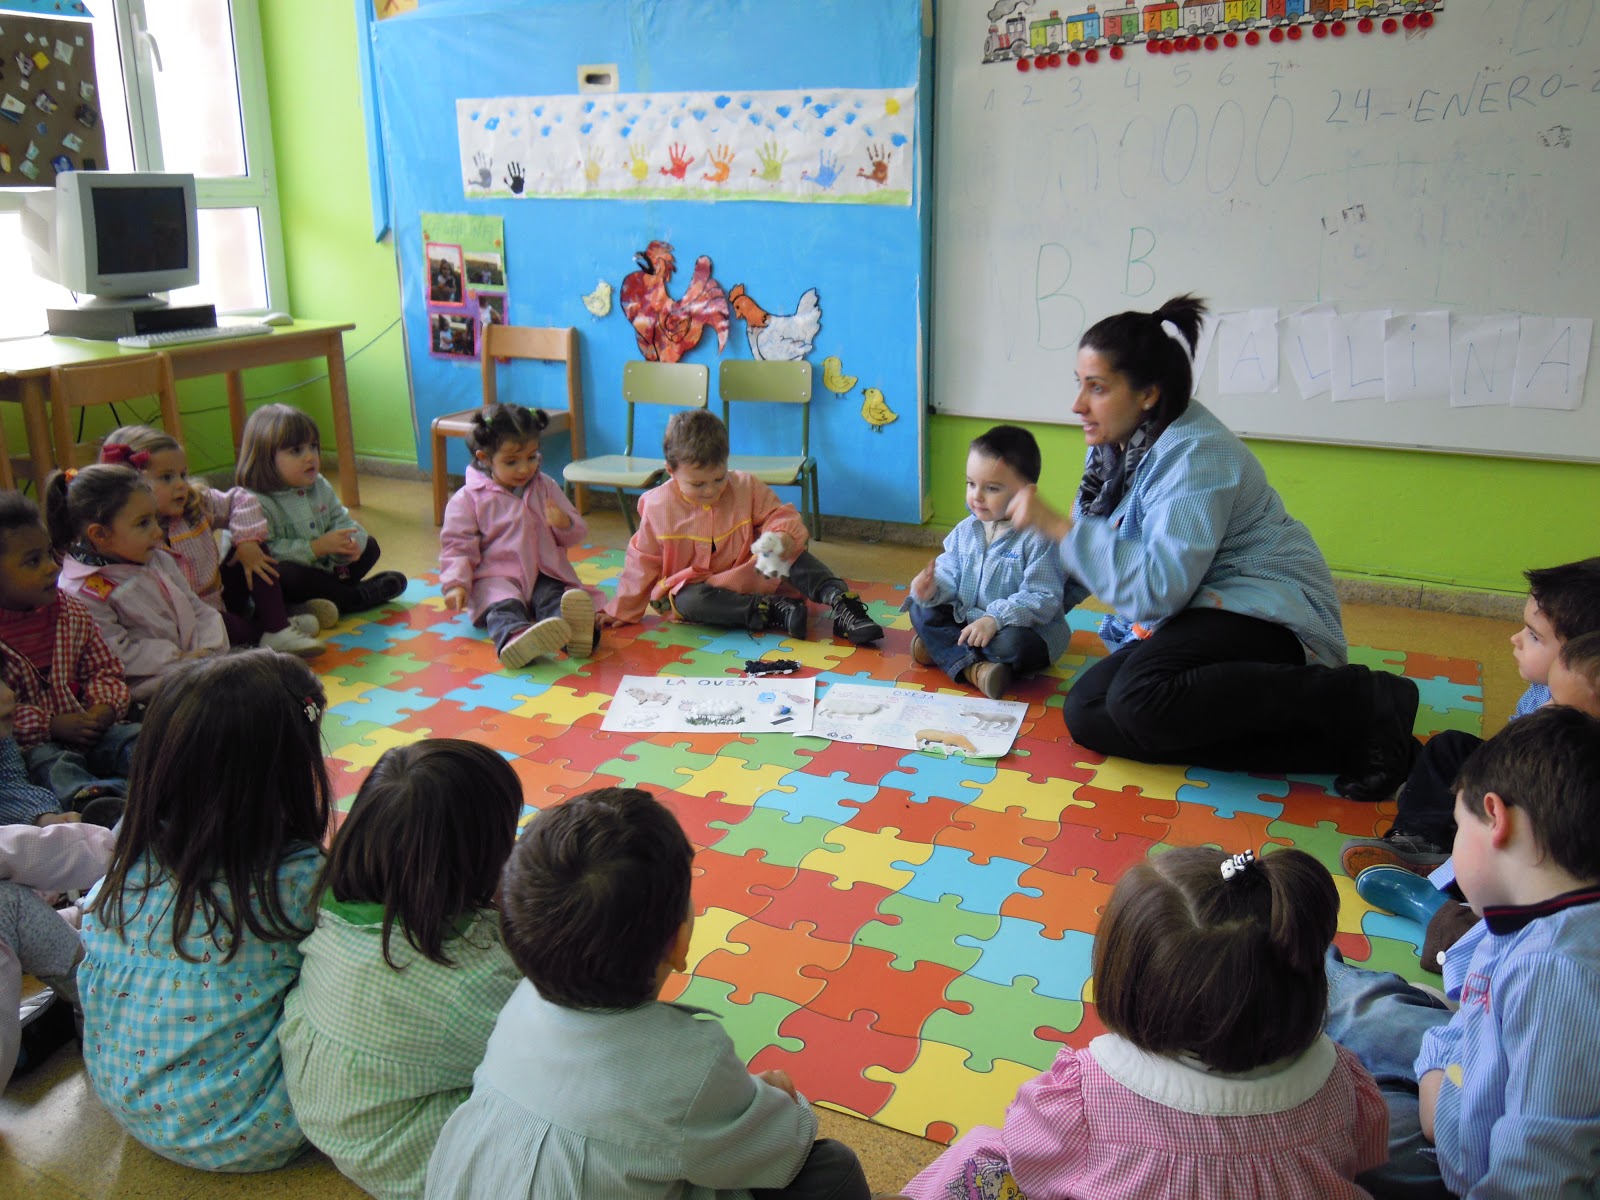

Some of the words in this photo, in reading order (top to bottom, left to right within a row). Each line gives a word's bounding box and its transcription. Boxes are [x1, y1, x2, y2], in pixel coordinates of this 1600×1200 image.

[1108, 17, 1117, 28] 5
[1166, 11, 1173, 22] 8
[1189, 8, 1197, 19] 9
[1202, 5, 1214, 17] 10
[1226, 3, 1239, 14] 11
[1245, 0, 1257, 12] 12
[1022, 84, 1042, 104] 2
[1064, 76, 1083, 108] 3
[1124, 66, 1141, 102] 4
[1173, 62, 1192, 88] 5
[1217, 61, 1235, 86] 6
[1267, 61, 1286, 89] 7
[1036, 242, 1086, 350] B
[1124, 226, 1156, 297] B
[666, 678, 687, 686] LA
